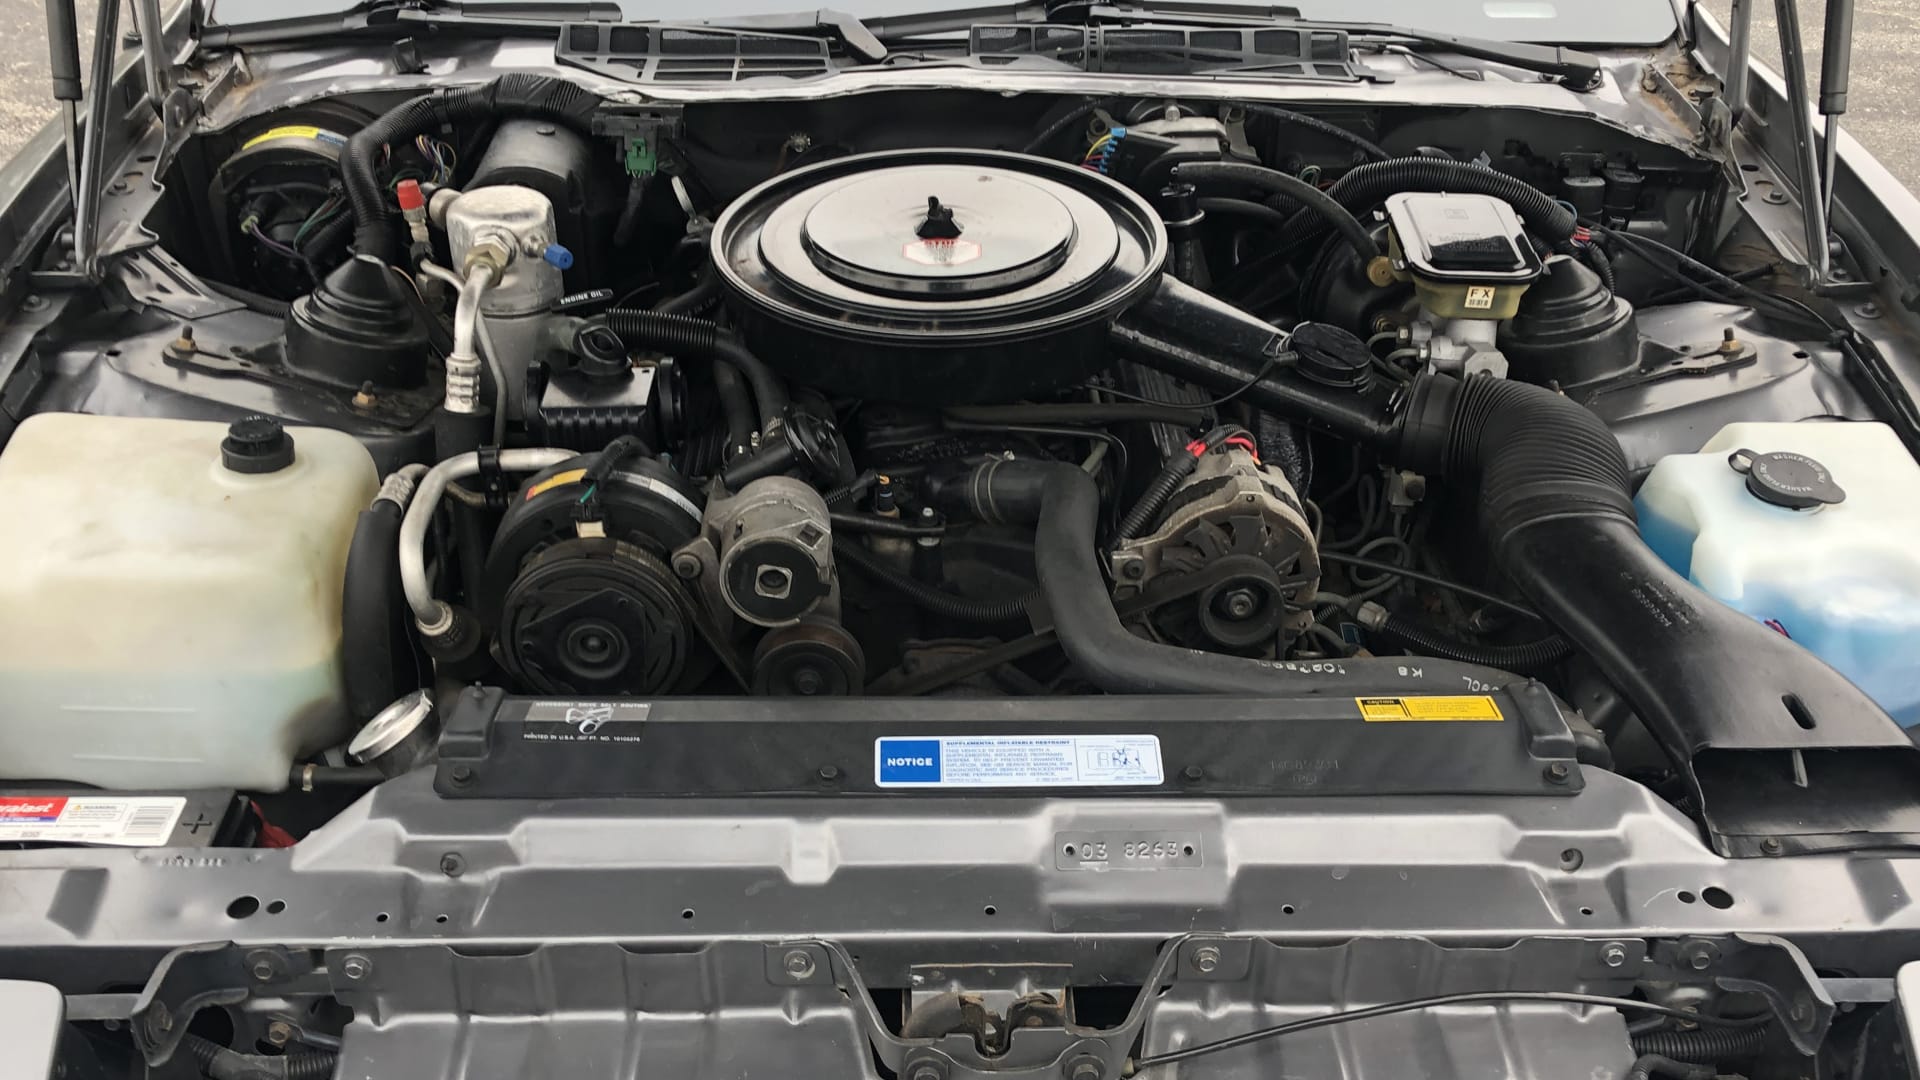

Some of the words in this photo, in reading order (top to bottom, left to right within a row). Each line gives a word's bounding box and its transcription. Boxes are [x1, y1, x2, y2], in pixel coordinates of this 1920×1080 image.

[560, 292, 588, 304] ENGINE
[590, 290, 604, 298] OIL
[1772, 454, 1804, 462] WASHER
[888, 758, 933, 766] NOTICE
[1080, 842, 1108, 859] 03
[1124, 841, 1178, 858] 8263
